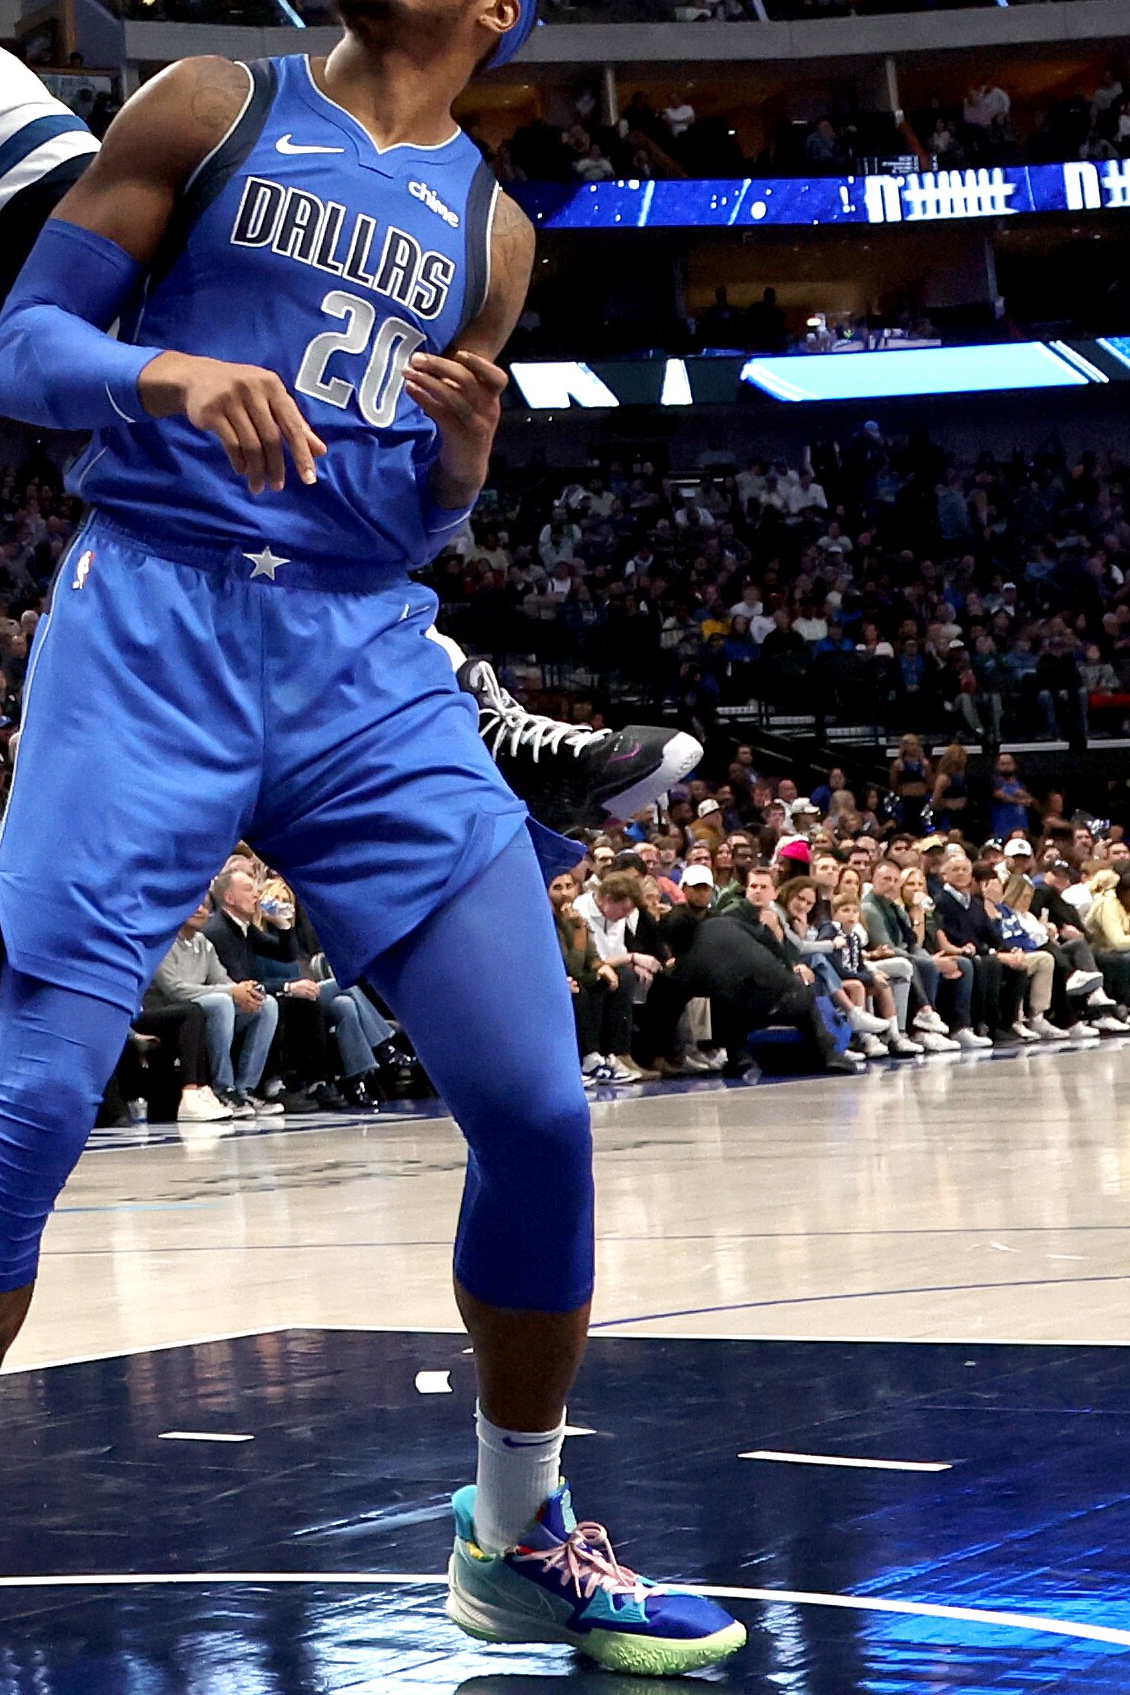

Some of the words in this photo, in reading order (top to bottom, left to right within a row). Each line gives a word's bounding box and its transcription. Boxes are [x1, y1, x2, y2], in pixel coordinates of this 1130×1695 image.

[230, 176, 455, 320] DALLAS
[408, 181, 458, 227] chime
[295, 290, 427, 428] 20
